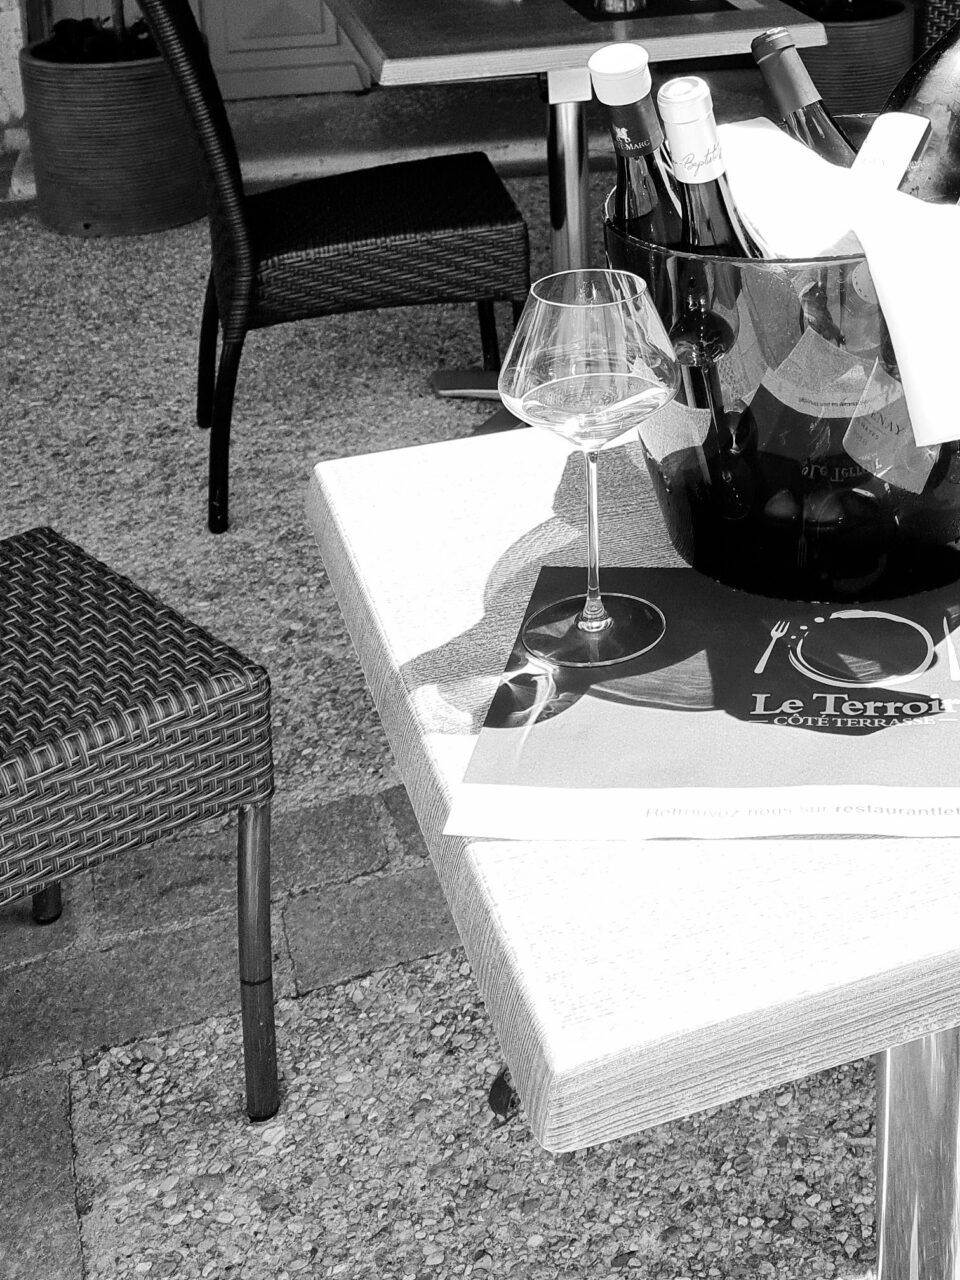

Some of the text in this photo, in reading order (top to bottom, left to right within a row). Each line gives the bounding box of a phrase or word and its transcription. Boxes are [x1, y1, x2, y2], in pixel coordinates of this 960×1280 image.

[749, 693, 804, 715] Le
[773, 714, 936, 728] CÔTÉ TERRASSE
